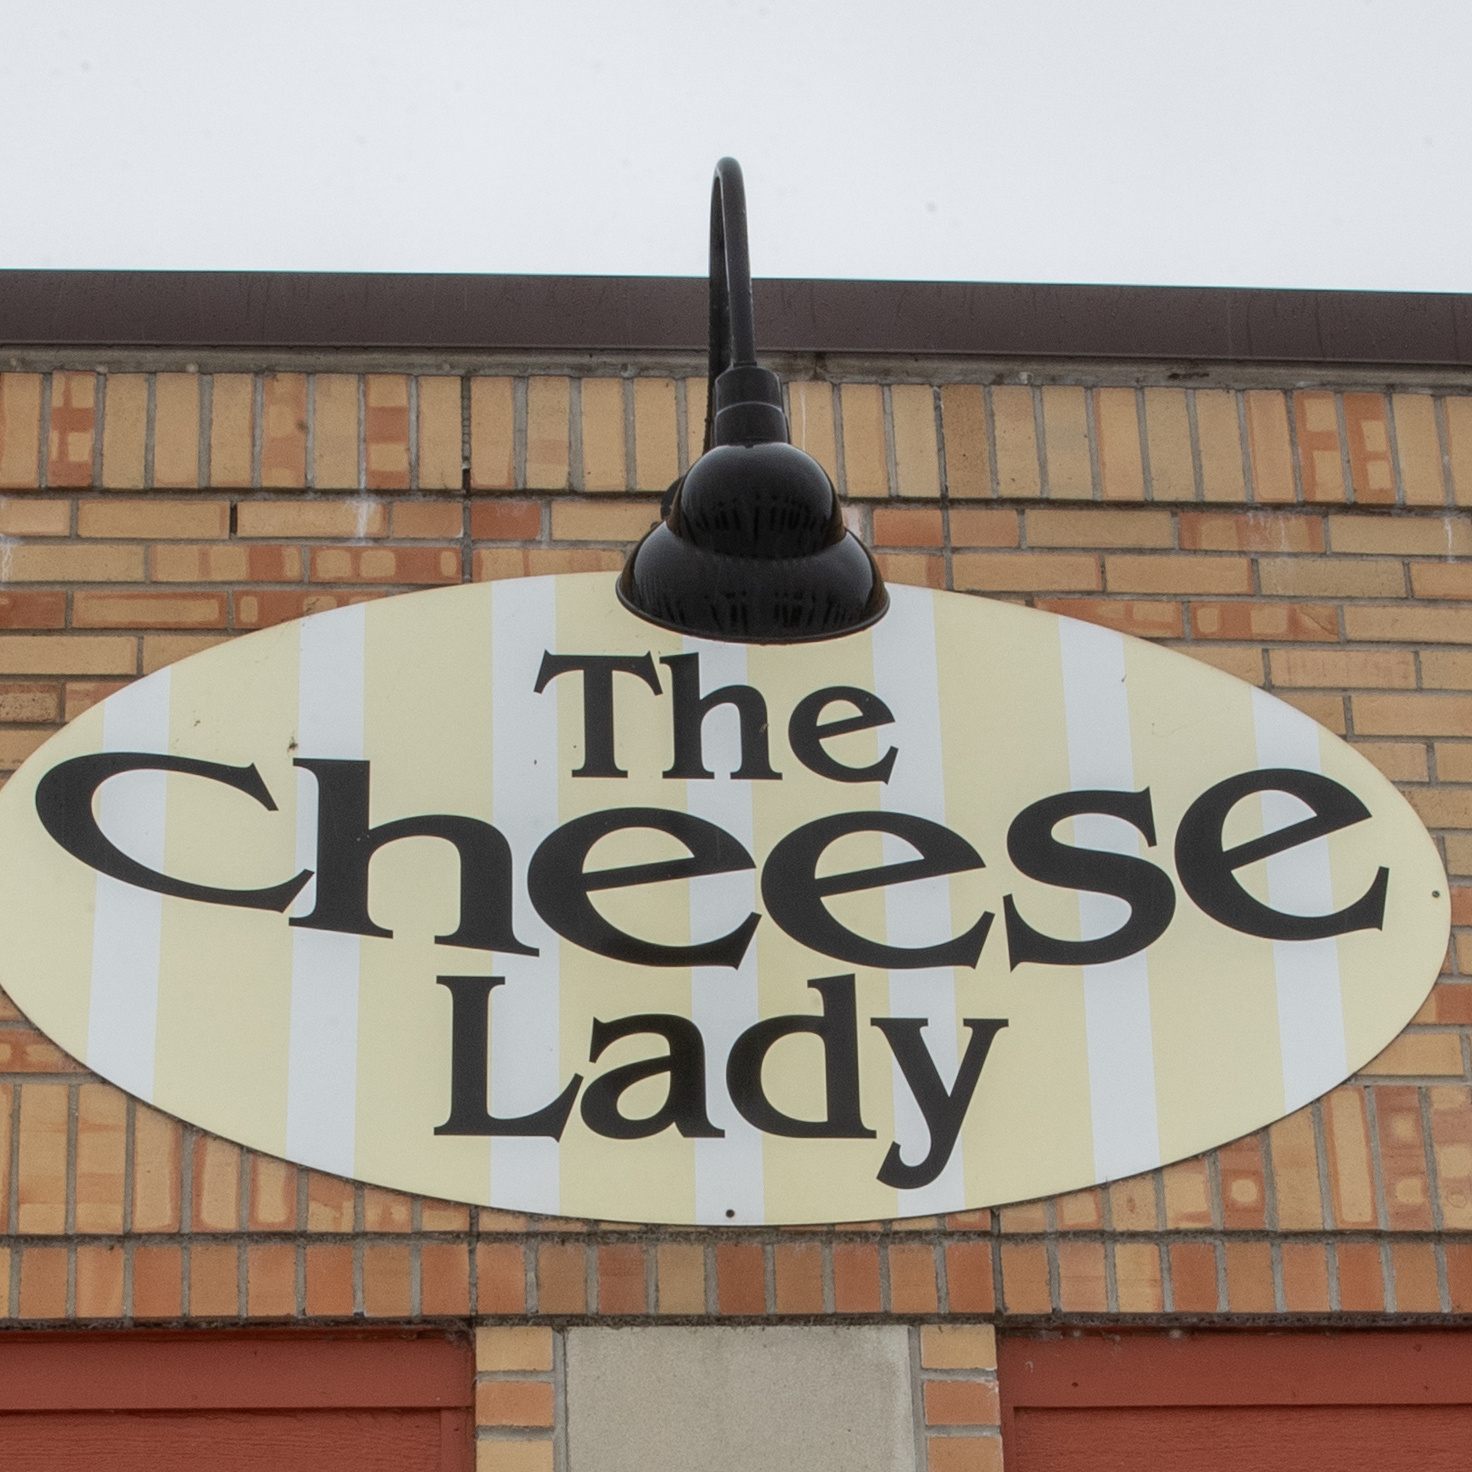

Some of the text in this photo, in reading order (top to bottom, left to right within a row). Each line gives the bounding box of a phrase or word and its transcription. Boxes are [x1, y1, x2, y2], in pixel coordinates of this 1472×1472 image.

[534, 651, 898, 784] The
[36, 753, 1389, 971] Cheese
[434, 974, 1008, 1189] Lady
